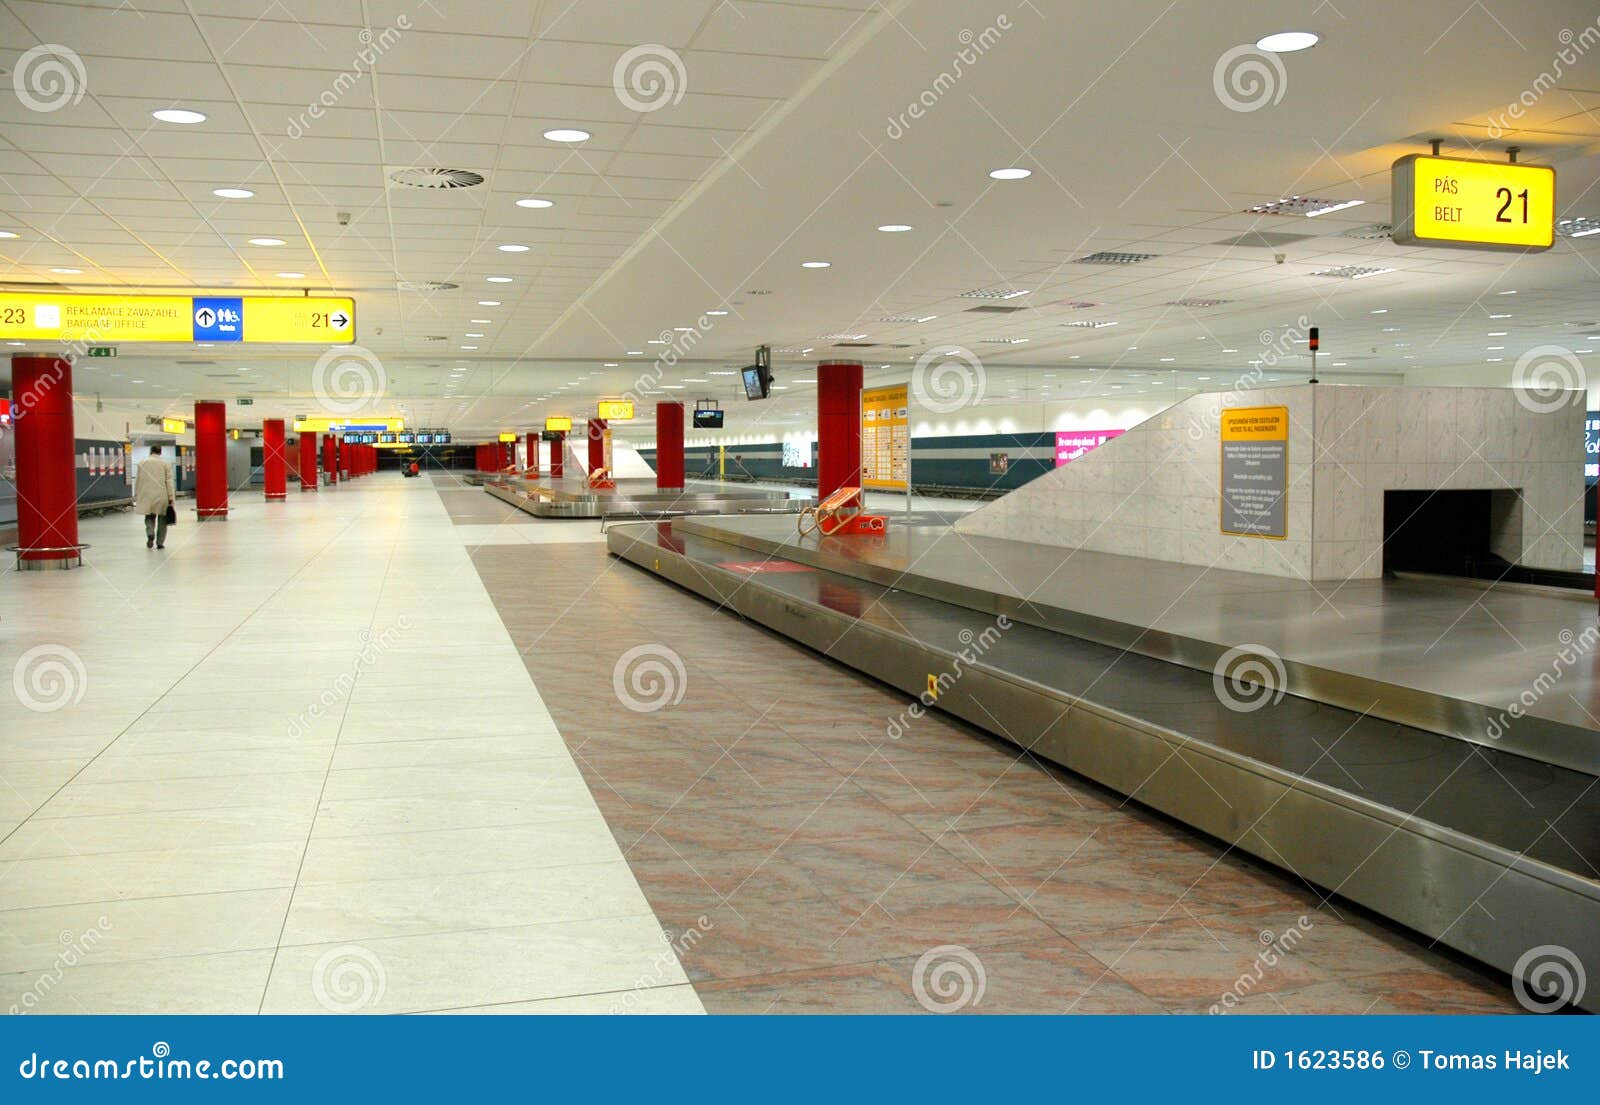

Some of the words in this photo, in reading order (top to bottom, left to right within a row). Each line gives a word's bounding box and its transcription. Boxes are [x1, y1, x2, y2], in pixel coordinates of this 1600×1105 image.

[1434, 176, 1458, 194] PÁS
[1496, 187, 1528, 224] 21
[1434, 206, 1463, 222] BELT
[66, 306, 123, 317] REKLAMACE
[127, 307, 179, 319] ZAVAZADEL
[311, 312, 329, 329] 21
[66, 319, 111, 329] BAGGAGE
[114, 320, 147, 329] OFFICE
